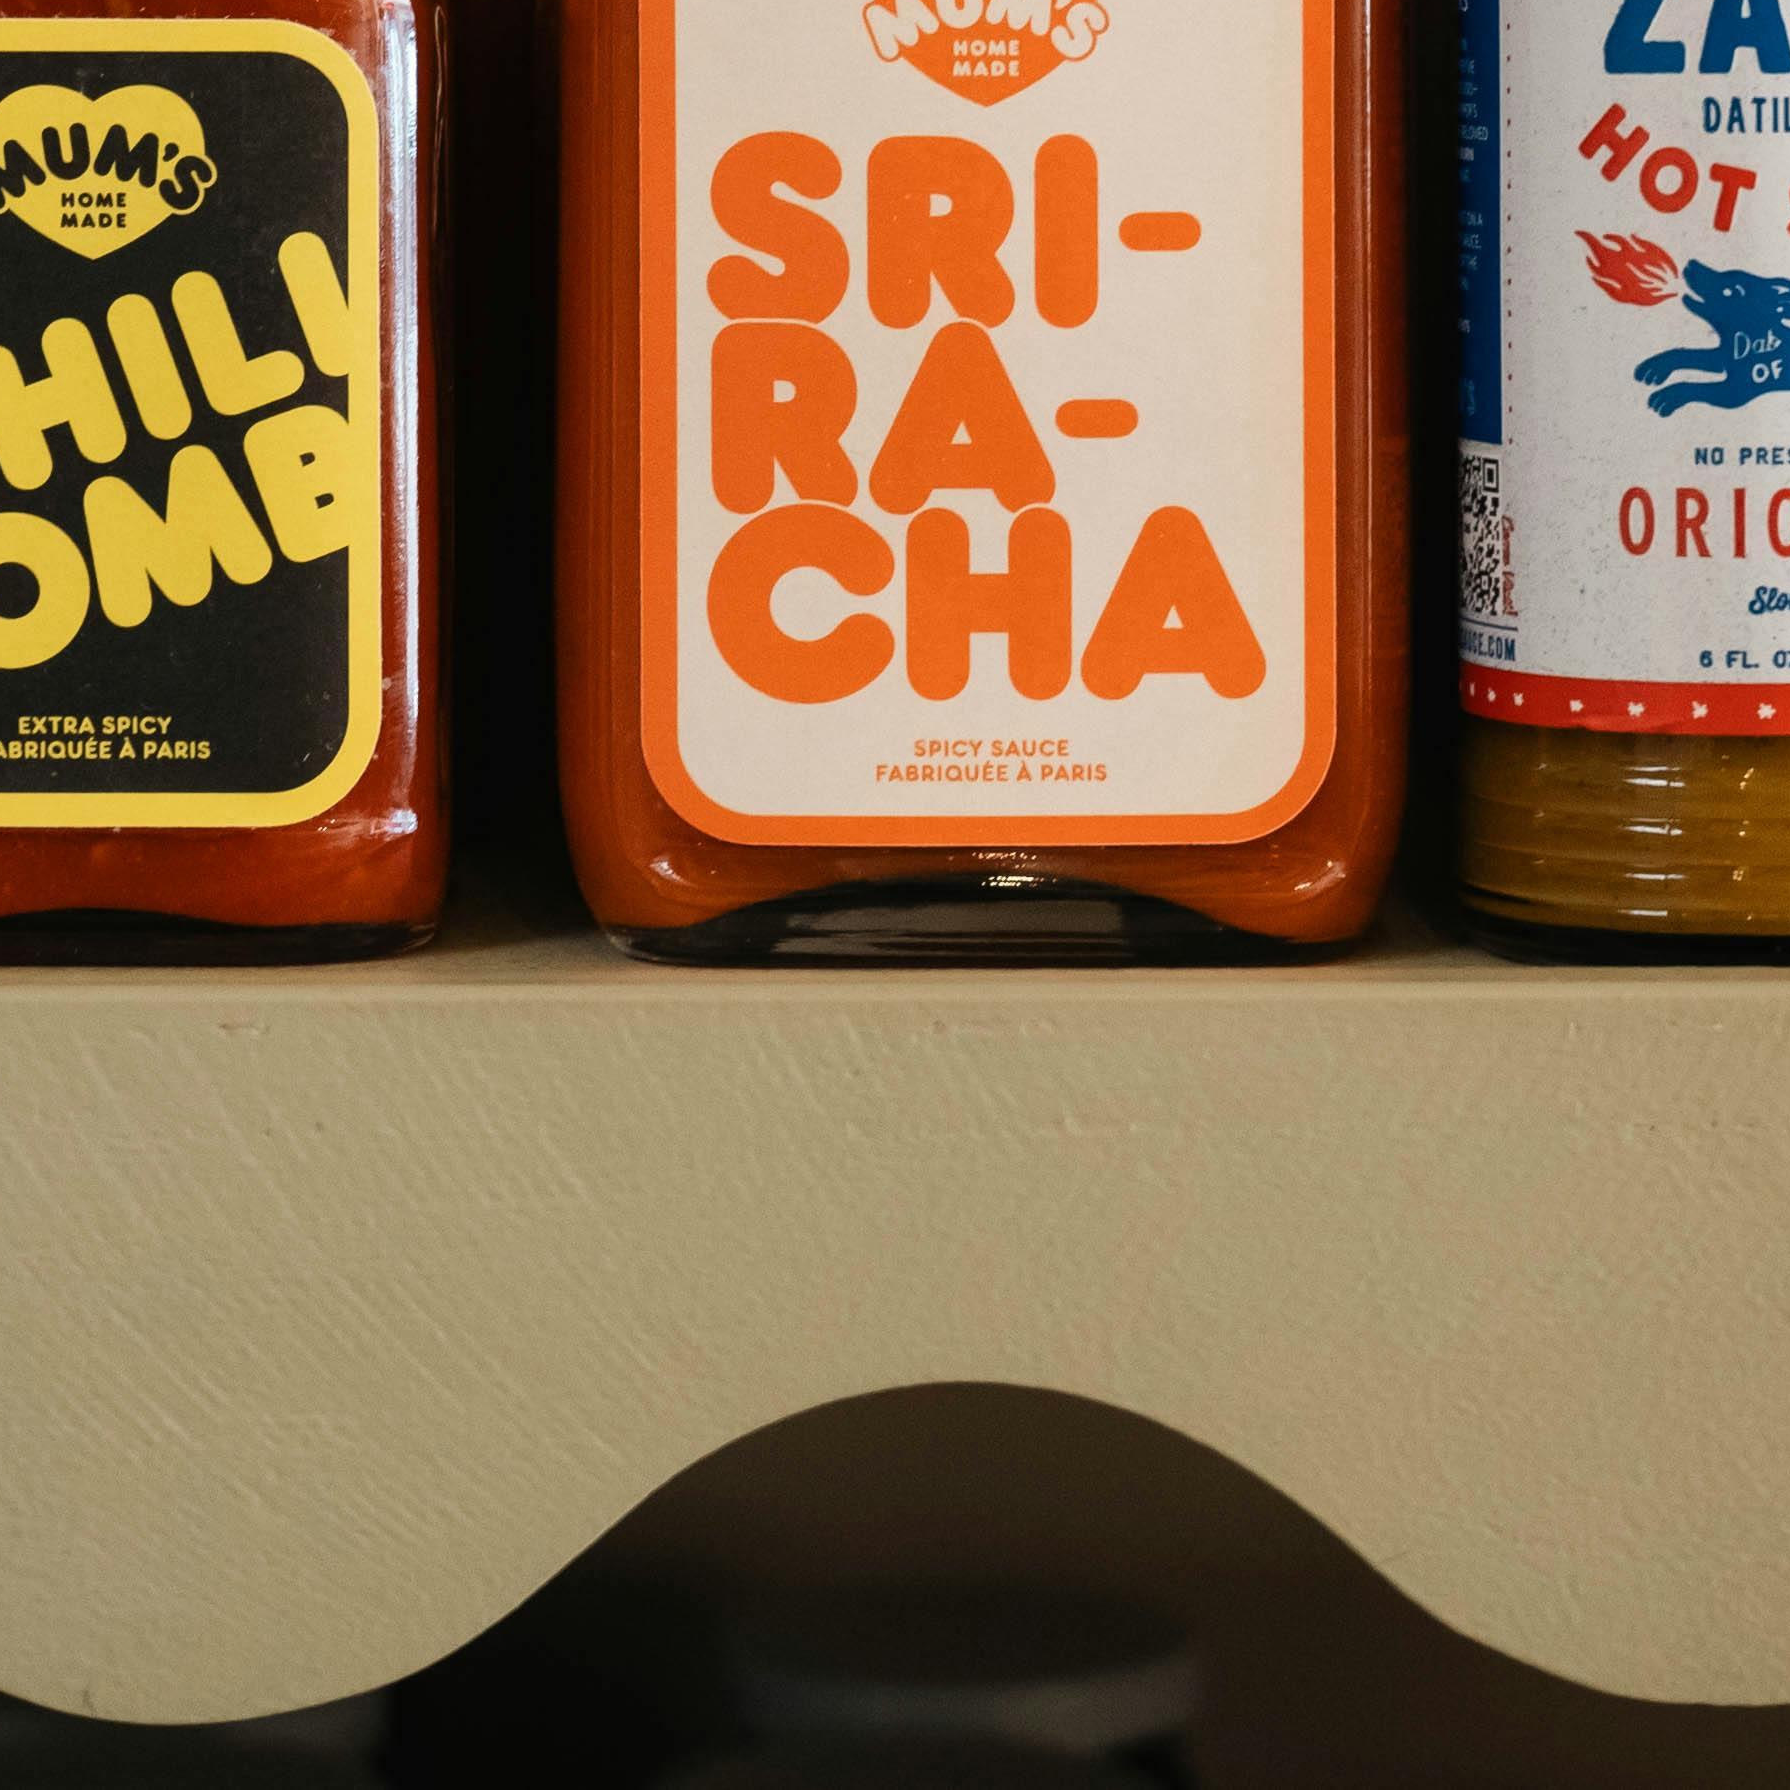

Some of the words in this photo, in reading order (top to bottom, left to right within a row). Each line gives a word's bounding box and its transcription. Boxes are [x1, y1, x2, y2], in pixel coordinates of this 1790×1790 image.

[953, 41, 1021, 56] HOME
[953, 61, 1021, 77] MADE
[1577, 100, 1758, 235] HOT
[60, 192, 127, 208] HOME
[60, 212, 127, 229] MADE
[706, 131, 1202, 329] SRI-
[1751, 361, 1784, 385] OF
[711, 321, 1139, 516] RA-
[1693, 445, 1724, 467] NO
[706, 502, 1267, 705] CHA
[1699, 648, 1714, 670] 6
[1726, 648, 1761, 671] FL.
[18, 716, 95, 735] EXTRA
[102, 715, 173, 736] SPICY
[120, 735, 137, 760] À
[143, 740, 211, 760] PARIS
[913, 739, 983, 758] SPICY
[993, 739, 1070, 758] SAUCE
[874, 758, 1010, 784] FABRIQUÉE
[1016, 758, 1035, 782] À
[1040, 763, 1108, 783] PARIS
